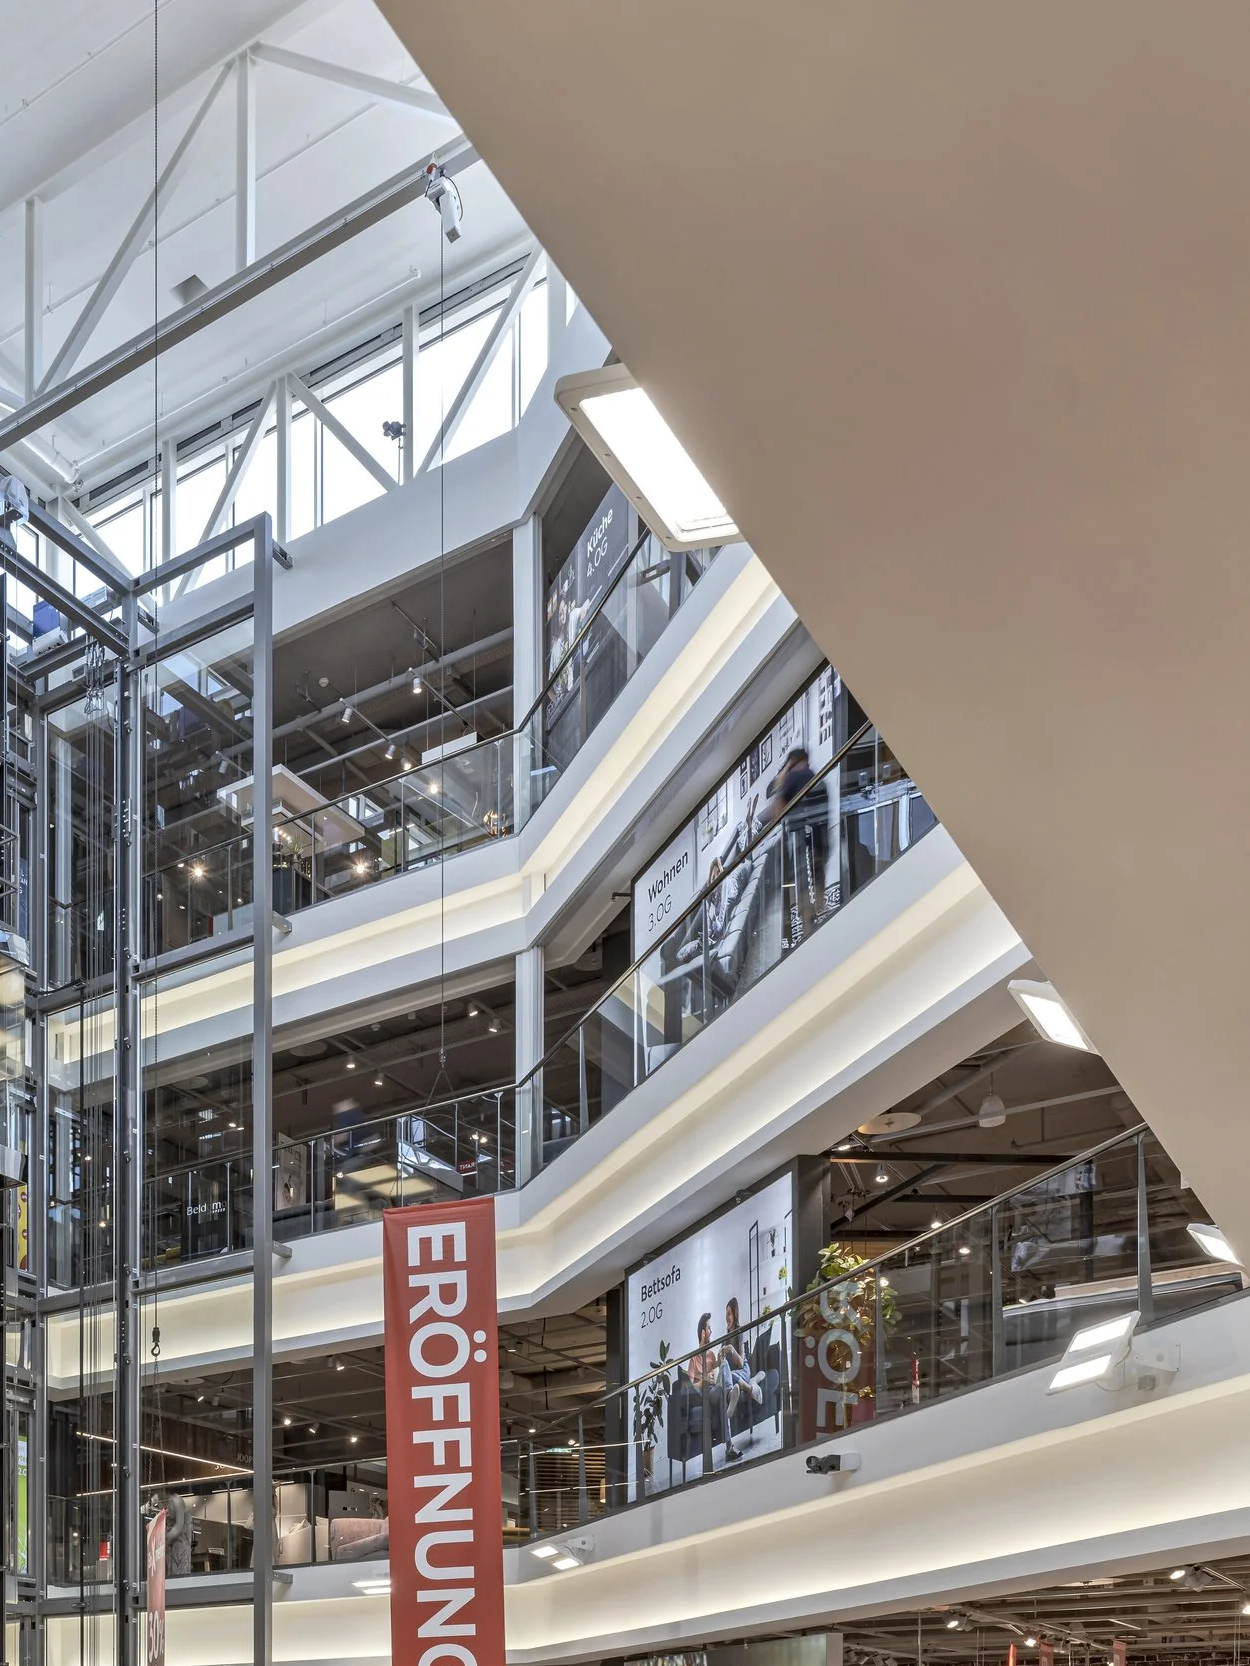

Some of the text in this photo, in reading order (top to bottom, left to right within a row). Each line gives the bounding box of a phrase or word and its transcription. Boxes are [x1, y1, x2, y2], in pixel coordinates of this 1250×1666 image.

[587, 509, 613, 558] Küche
[648, 851, 689, 903] Wohnen
[648, 894, 672, 932] 3.OG
[640, 1265, 681, 1303] Bettsofa
[640, 1301, 664, 1330] 2.OG
